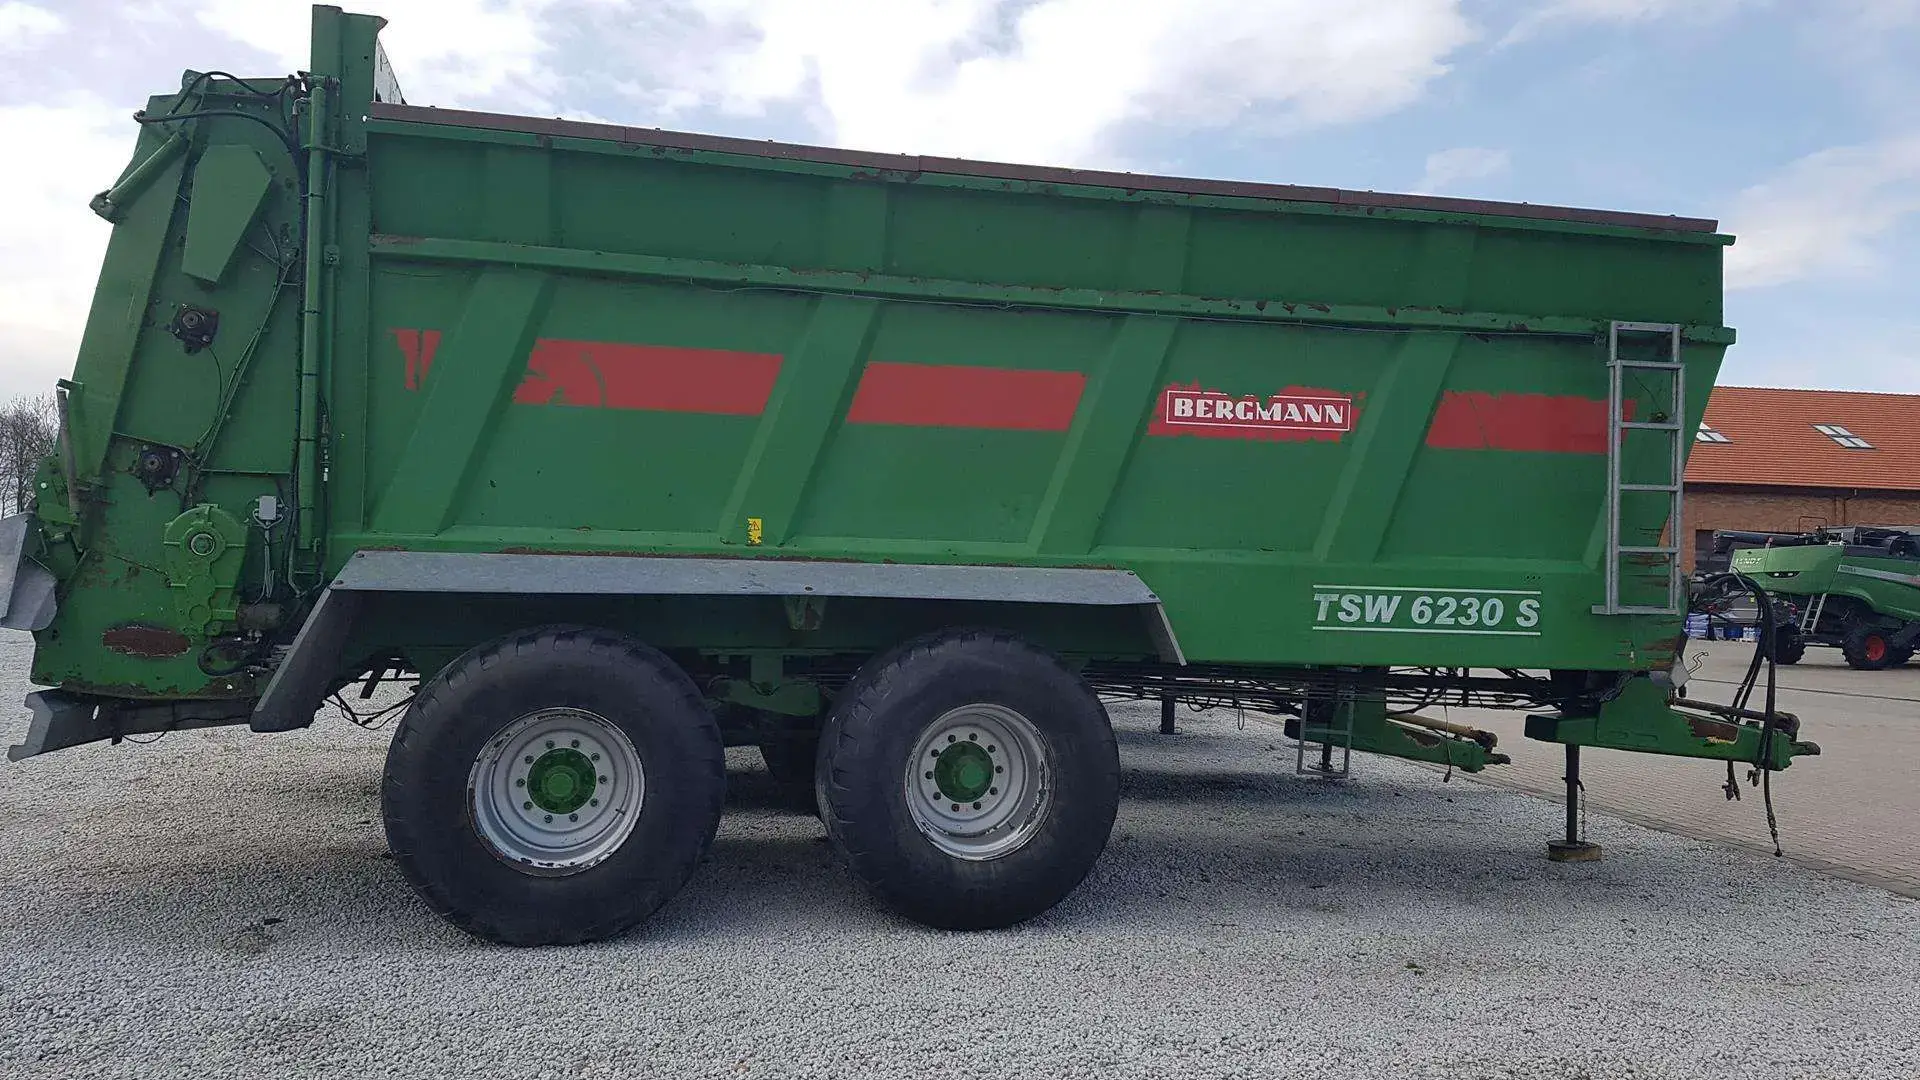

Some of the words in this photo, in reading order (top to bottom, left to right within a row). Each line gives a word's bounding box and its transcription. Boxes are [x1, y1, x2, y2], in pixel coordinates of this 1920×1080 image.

[1174, 398, 1344, 424] BERGMANN
[1313, 593, 1402, 624] TSW
[1411, 596, 1504, 627] 6230
[1516, 599, 1540, 628] S
